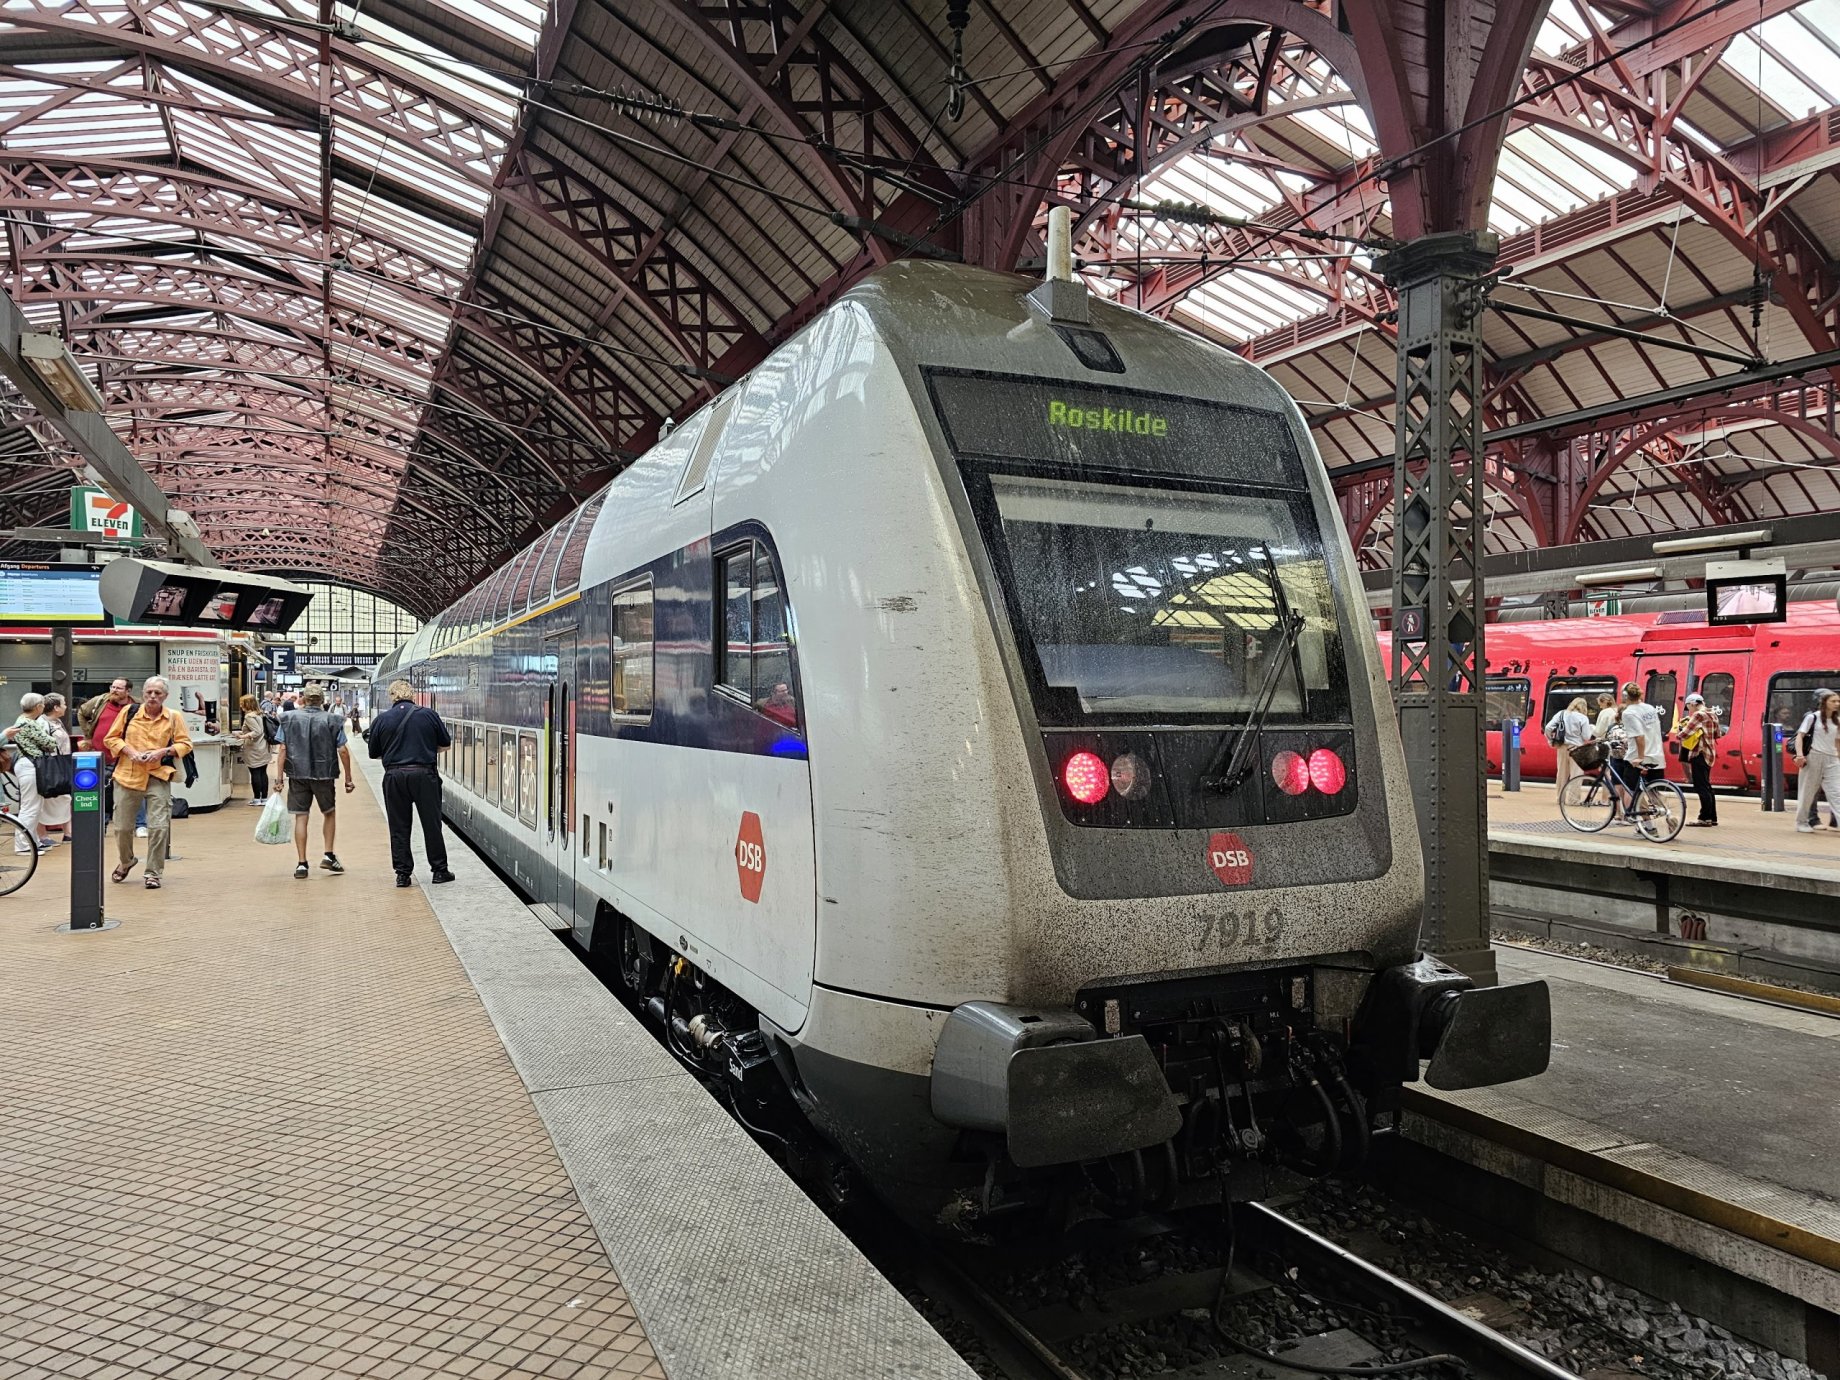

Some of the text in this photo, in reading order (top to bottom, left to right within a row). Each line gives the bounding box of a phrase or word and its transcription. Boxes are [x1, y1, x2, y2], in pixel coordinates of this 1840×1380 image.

[1049, 401, 1167, 436] Roskilde
[92, 497, 128, 537] 7
[273, 651, 288, 670] E
[739, 839, 762, 873] DSB
[1212, 850, 1250, 868] DSB
[1199, 907, 1284, 953] 7919
